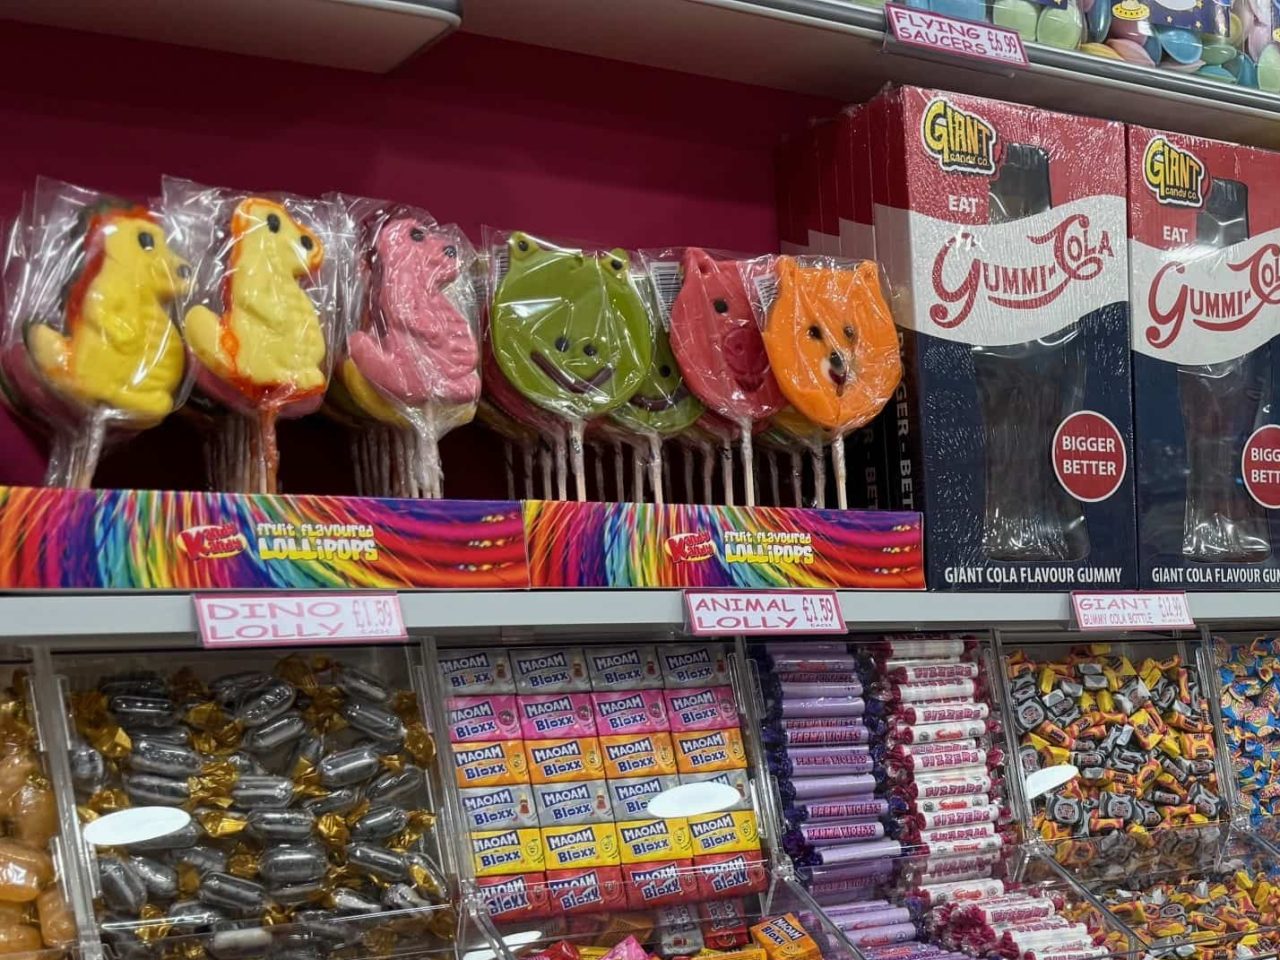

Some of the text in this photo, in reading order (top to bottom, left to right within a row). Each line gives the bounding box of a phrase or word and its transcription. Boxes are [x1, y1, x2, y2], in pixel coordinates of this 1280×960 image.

[894, 11, 980, 40] FLYING
[899, 27, 987, 55] SAUCERS
[924, 100, 992, 164] GIANT
[1145, 138, 1201, 196] GIANT
[949, 195, 980, 214] EAT
[1163, 225, 1188, 243] EAT
[1062, 434, 1116, 453] BIGGER
[1063, 458, 1117, 477] BETTER
[257, 523, 374, 538] fruit flavoured
[945, 566, 1122, 584] GIANT COLA FLAVOUR GUMMY
[1152, 567, 1183, 584] GIANT
[1185, 568, 1212, 584] COLA
[1214, 568, 1260, 584] FLAVOUR
[208, 599, 393, 628] DINO £1.59
[695, 597, 834, 623] ANIMAL £1.59
[1079, 598, 1152, 610] GIANT
[209, 622, 344, 640] LOLLY
[697, 616, 798, 628] LOLLY
[456, 745, 504, 765] MAOAM
[466, 791, 513, 809] MAOAM
[692, 817, 733, 837] MAOAM
